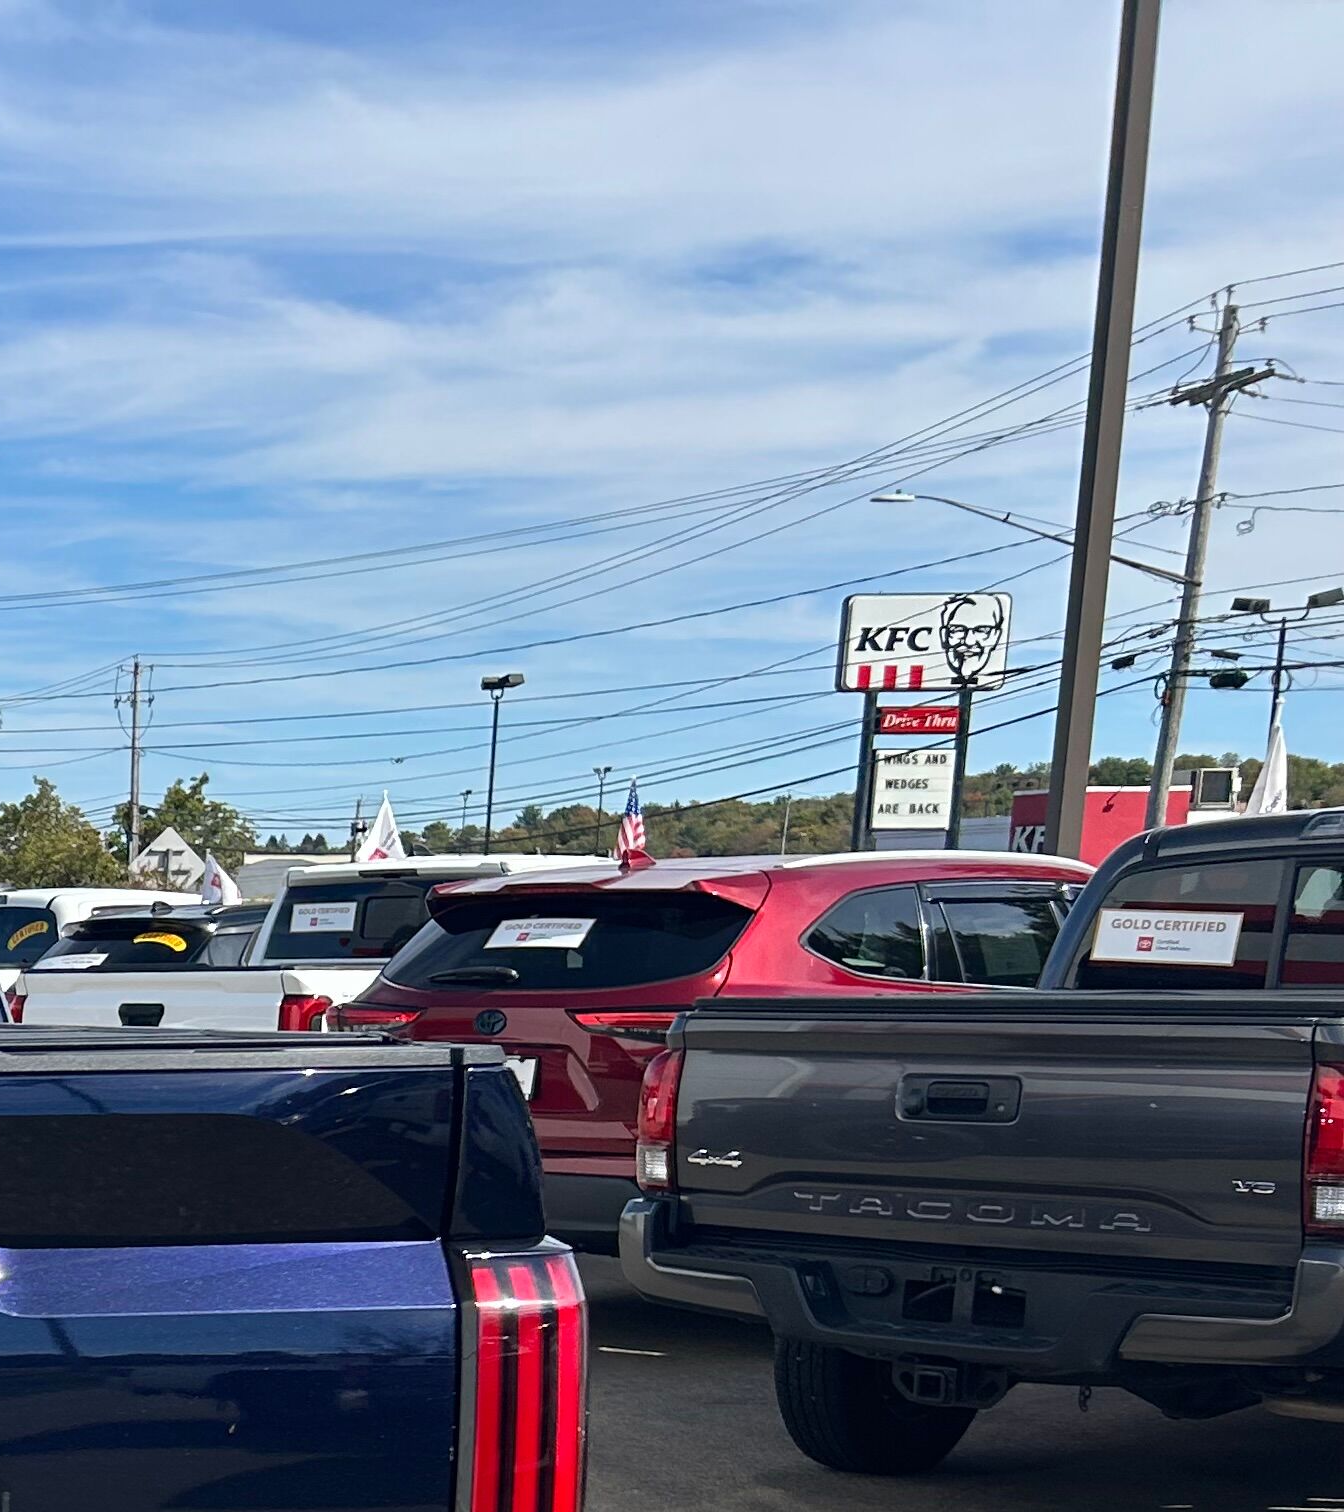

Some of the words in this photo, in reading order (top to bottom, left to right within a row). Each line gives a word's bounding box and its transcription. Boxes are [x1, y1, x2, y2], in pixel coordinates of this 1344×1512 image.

[854, 626, 932, 652] KFC
[882, 713, 920, 728] Drive
[924, 713, 957, 728] Thru
[883, 753, 919, 765] WINGS
[925, 753, 947, 765] AND
[885, 778, 930, 790] WEDGES
[878, 803, 899, 814] ARE
[909, 803, 940, 814] BACK
[1012, 826, 1046, 852] KF
[532, 922, 582, 930] CERTIFIED
[1111, 918, 1151, 930] GOLD
[1154, 919, 1227, 933] CERTIFIED
[1231, 1180, 1276, 1194] V6
[793, 1191, 1152, 1232] TACOMA
